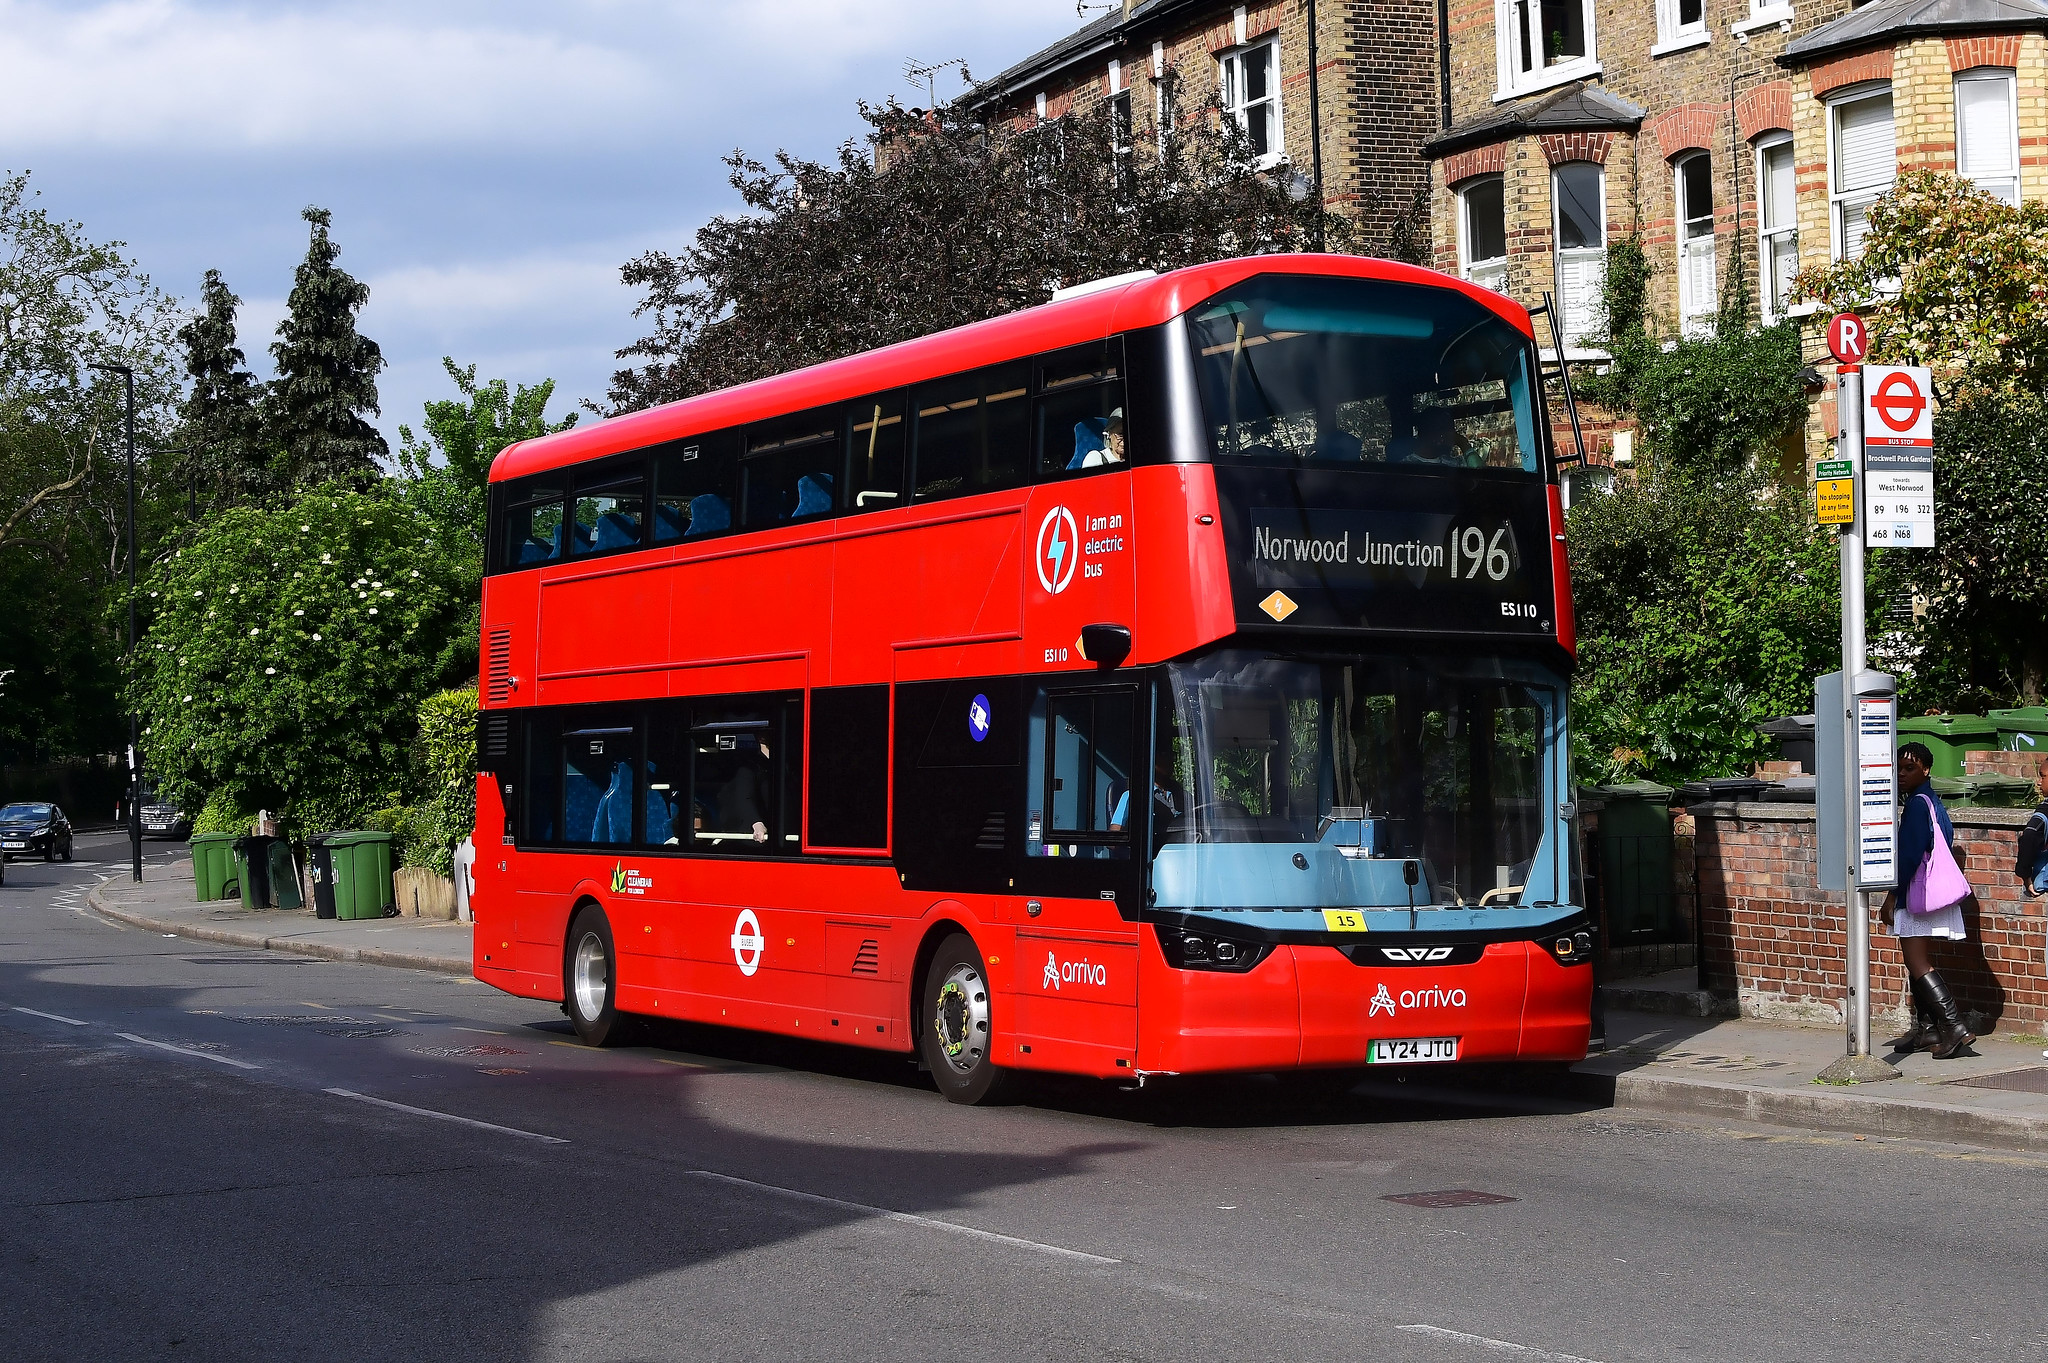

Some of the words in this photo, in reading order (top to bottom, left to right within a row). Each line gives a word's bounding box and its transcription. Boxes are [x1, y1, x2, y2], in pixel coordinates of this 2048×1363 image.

[1840, 319, 1861, 356] R
[1874, 505, 1884, 514] 89
[1896, 505, 1909, 514] 196
[1917, 505, 1930, 514] 322
[1086, 515, 1090, 532] I
[1092, 517, 1106, 530] am
[1109, 514, 1122, 529] an
[1872, 530, 1888, 538] 468
[1894, 530, 1911, 538] N68
[1085, 534, 1124, 555] electric
[1255, 526, 1348, 564] Norwood
[1356, 532, 1444, 568] Junction
[1450, 526, 1510, 582] 196
[1084, 561, 1103, 578] bus
[1501, 602, 1537, 618] ES110
[1044, 648, 1068, 663] ES110
[1336, 914, 1355, 928] 15
[1062, 957, 1106, 986] arriva
[1400, 984, 1467, 1008] arriva
[1378, 1042, 1418, 1060] LY24
[1424, 1040, 1454, 1058] JTO
